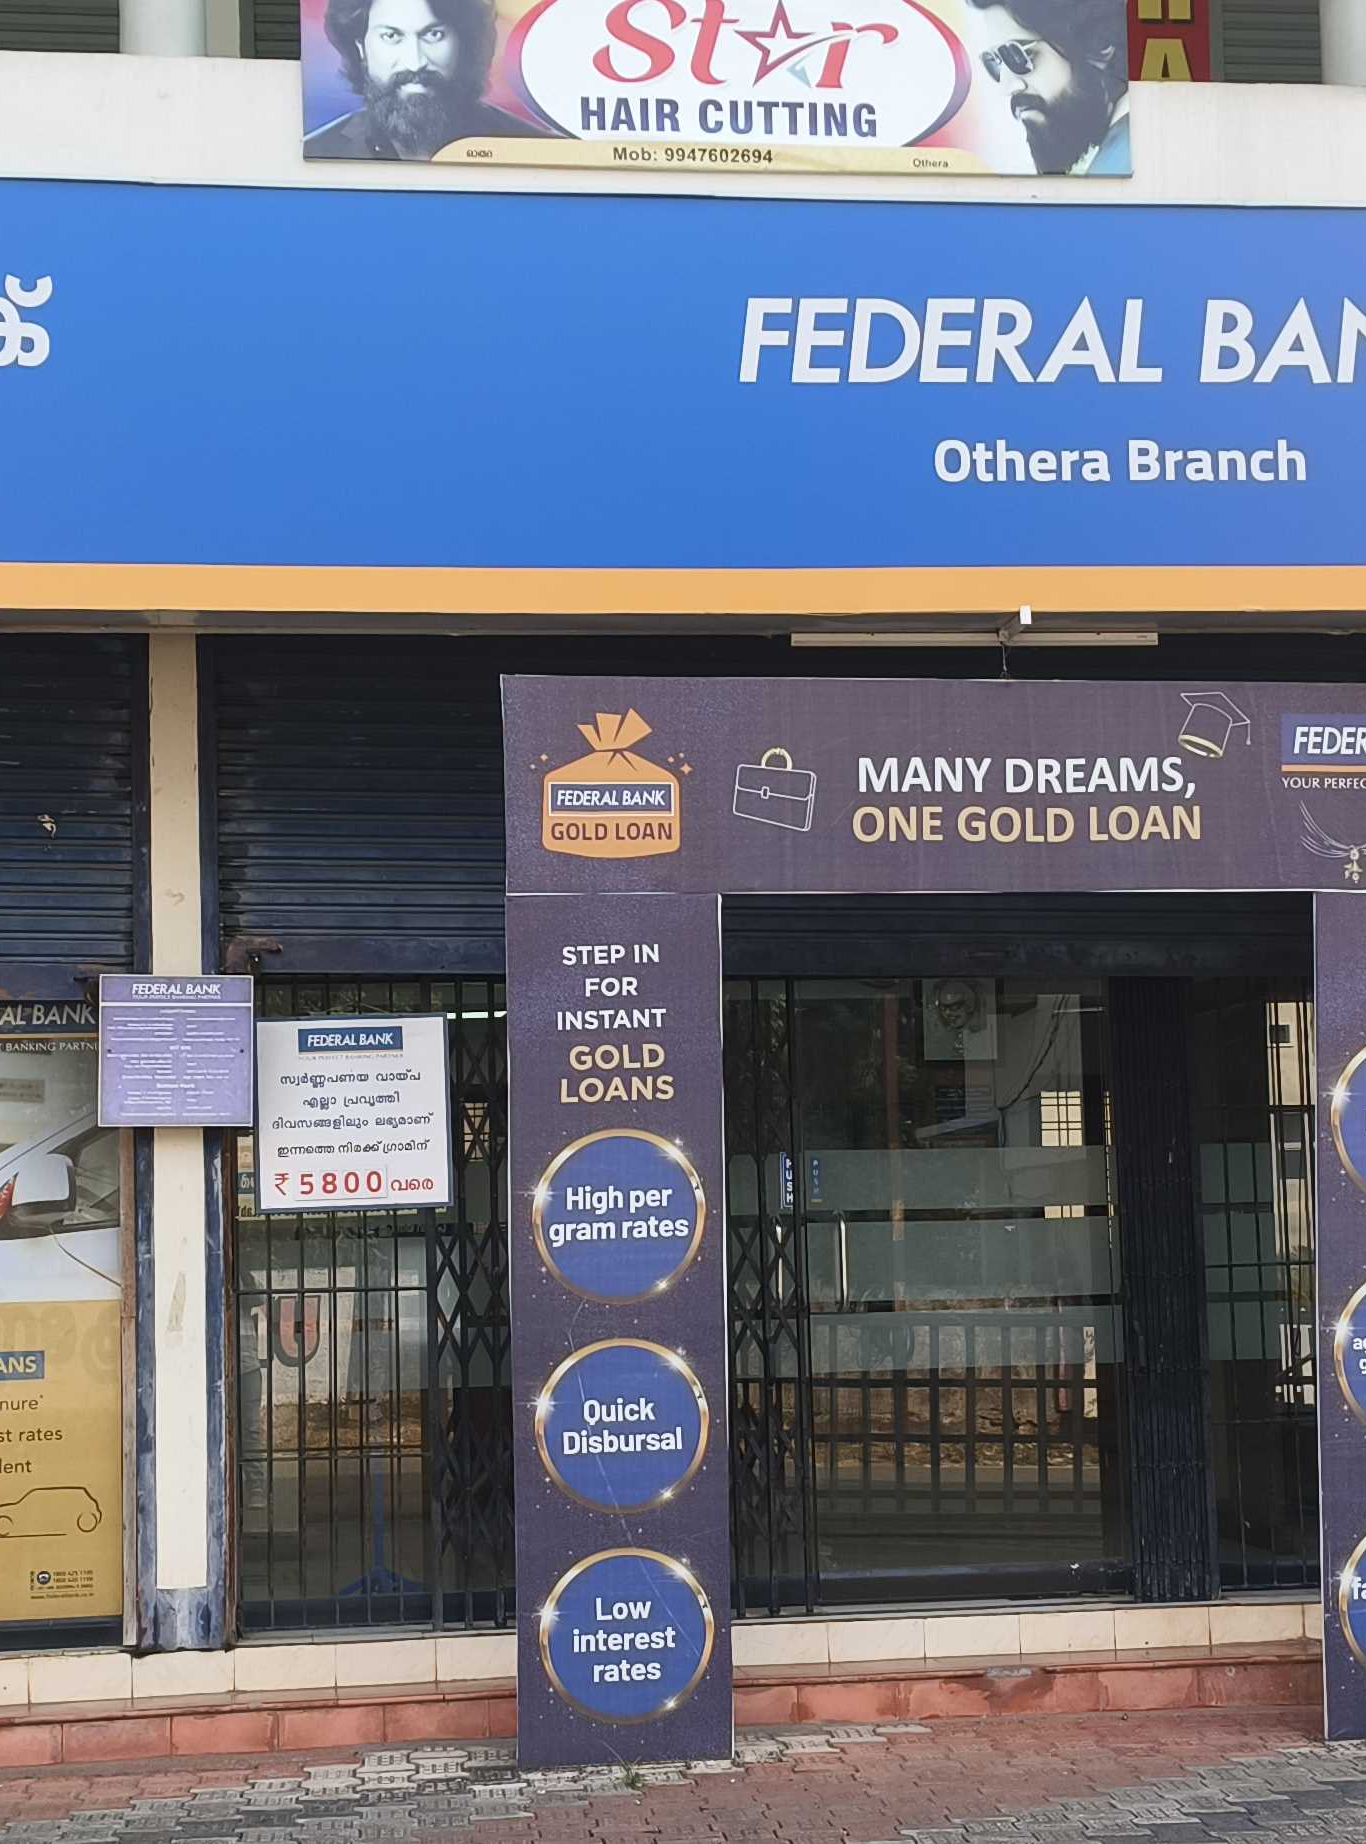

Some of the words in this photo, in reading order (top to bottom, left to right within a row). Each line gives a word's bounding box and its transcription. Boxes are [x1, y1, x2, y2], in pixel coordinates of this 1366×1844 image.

[581, 96, 680, 133] HAIR
[699, 98, 877, 138] CUTTING
[612, 146, 658, 162] Mob:
[665, 147, 774, 164] 9947602694
[913, 156, 950, 169] Othera
[737, 295, 1163, 384] FEDERAL
[933, 439, 1111, 482] Othera
[1127, 438, 1308, 482] Branch
[858, 756, 992, 794] MANY
[1005, 756, 1197, 800] DREAMS,
[1281, 776, 1320, 789] YOUR
[556, 788, 620, 807] FEDERAL
[622, 789, 666, 807] BANK
[550, 822, 608, 842] GOLD
[614, 821, 673, 841] LOAN
[851, 805, 944, 843] ONE
[957, 805, 1075, 844] GOLD
[1088, 804, 1202, 842] LOAN
[562, 945, 626, 966] STEP
[633, 944, 660, 963] IN
[584, 977, 638, 998] FOR
[31, 1003, 96, 1025] BANK
[557, 1008, 667, 1031] INSTANT
[306, 1034, 357, 1048] FEDERAL
[358, 1032, 394, 1047] BANK
[569, 1043, 666, 1071] GOLD
[560, 1075, 675, 1104] LOANS
[299, 1170, 383, 1195] 5800
[565, 1185, 626, 1217] High
[628, 1187, 673, 1217] per
[548, 1221, 617, 1248] gram
[621, 1214, 689, 1240] rates
[582, 1397, 655, 1426] Quick
[18, 1425, 63, 1443] rates
[562, 1426, 683, 1455] Disbursal
[595, 1597, 652, 1621] Low
[572, 1624, 676, 1653] interest
[592, 1658, 662, 1683] rates
